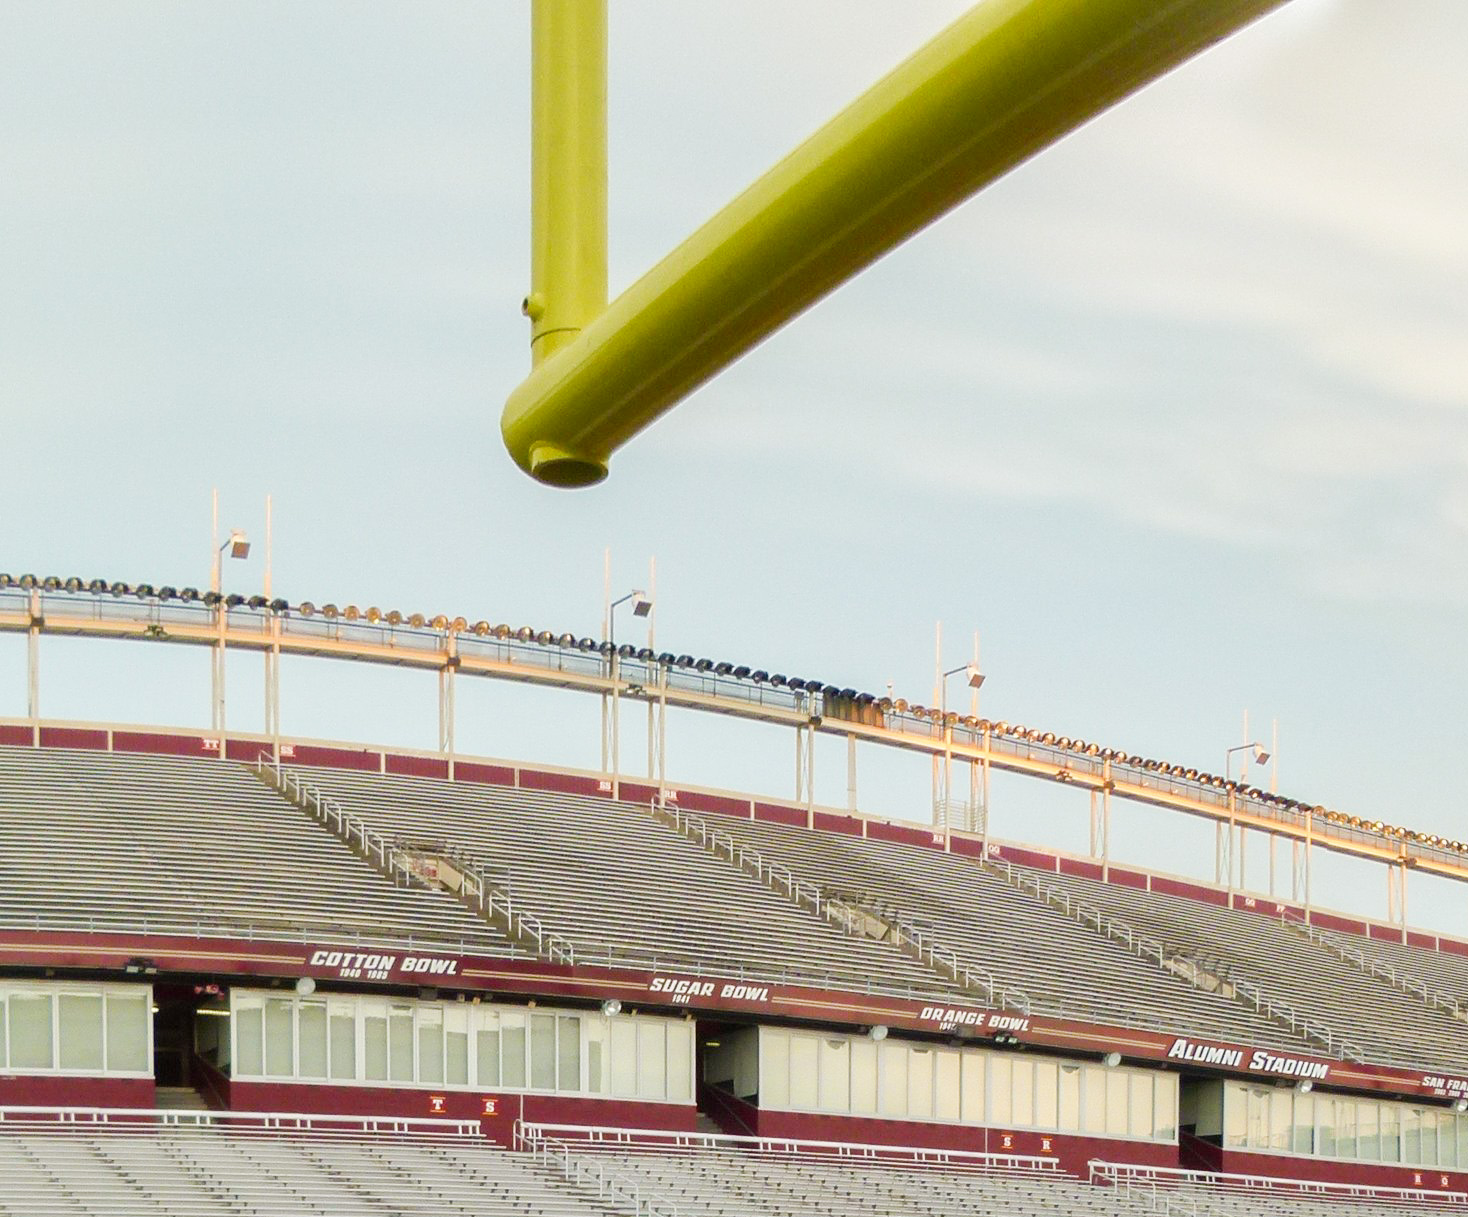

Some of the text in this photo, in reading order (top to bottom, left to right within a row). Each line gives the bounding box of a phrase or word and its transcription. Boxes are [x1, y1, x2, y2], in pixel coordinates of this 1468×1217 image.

[310, 950, 458, 975] COTTON BOWL
[650, 977, 769, 1002] SUGAR BOWL
[920, 1007, 1030, 1031] ORANGE BOWL
[1168, 1039, 1329, 1079] ALUMNI STADIUM
[1422, 1076, 1445, 1088] SAN
[432, 1099, 443, 1110] T
[486, 1102, 495, 1112] S
[1004, 1137, 1011, 1147] S
[1043, 1140, 1050, 1150] R
